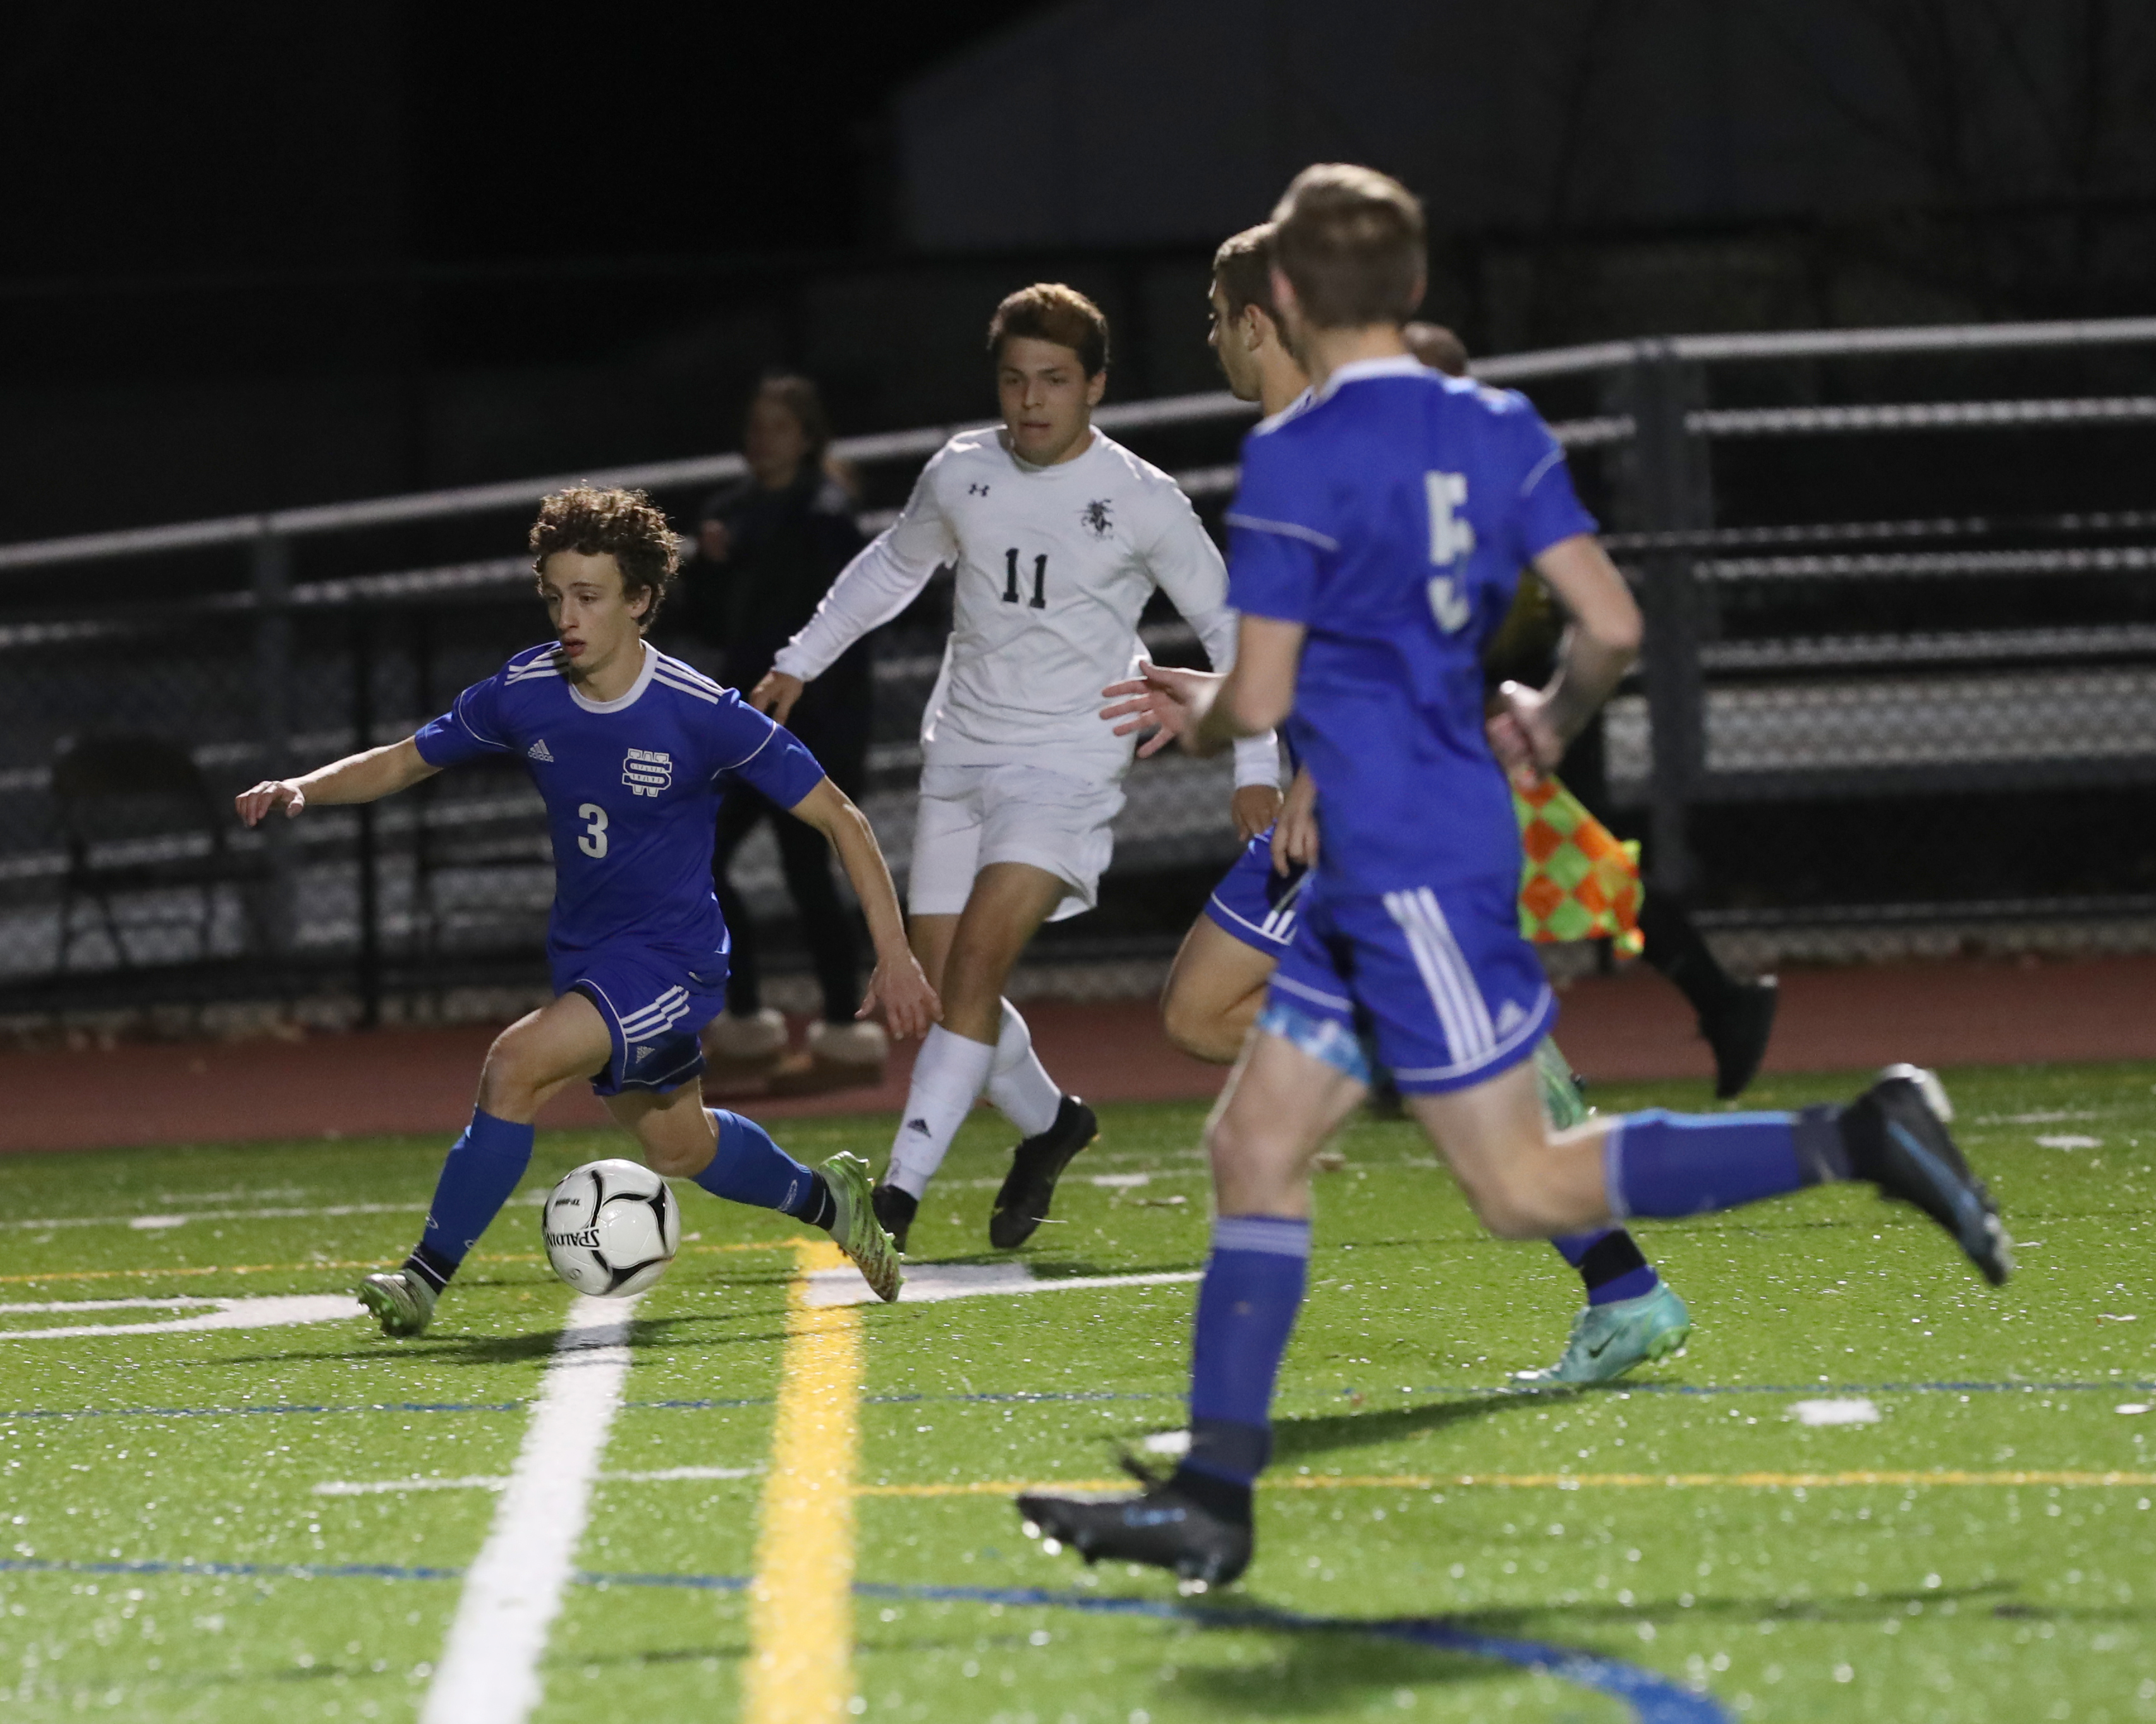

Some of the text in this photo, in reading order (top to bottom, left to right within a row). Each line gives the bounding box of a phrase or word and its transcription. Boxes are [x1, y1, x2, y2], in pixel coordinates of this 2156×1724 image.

[1002, 547, 1048, 609] 11
[1425, 470, 1477, 634] 5
[528, 751, 554, 762] adidas
[577, 802, 609, 859] 3
[545, 1229, 600, 1248] SPALDIN
